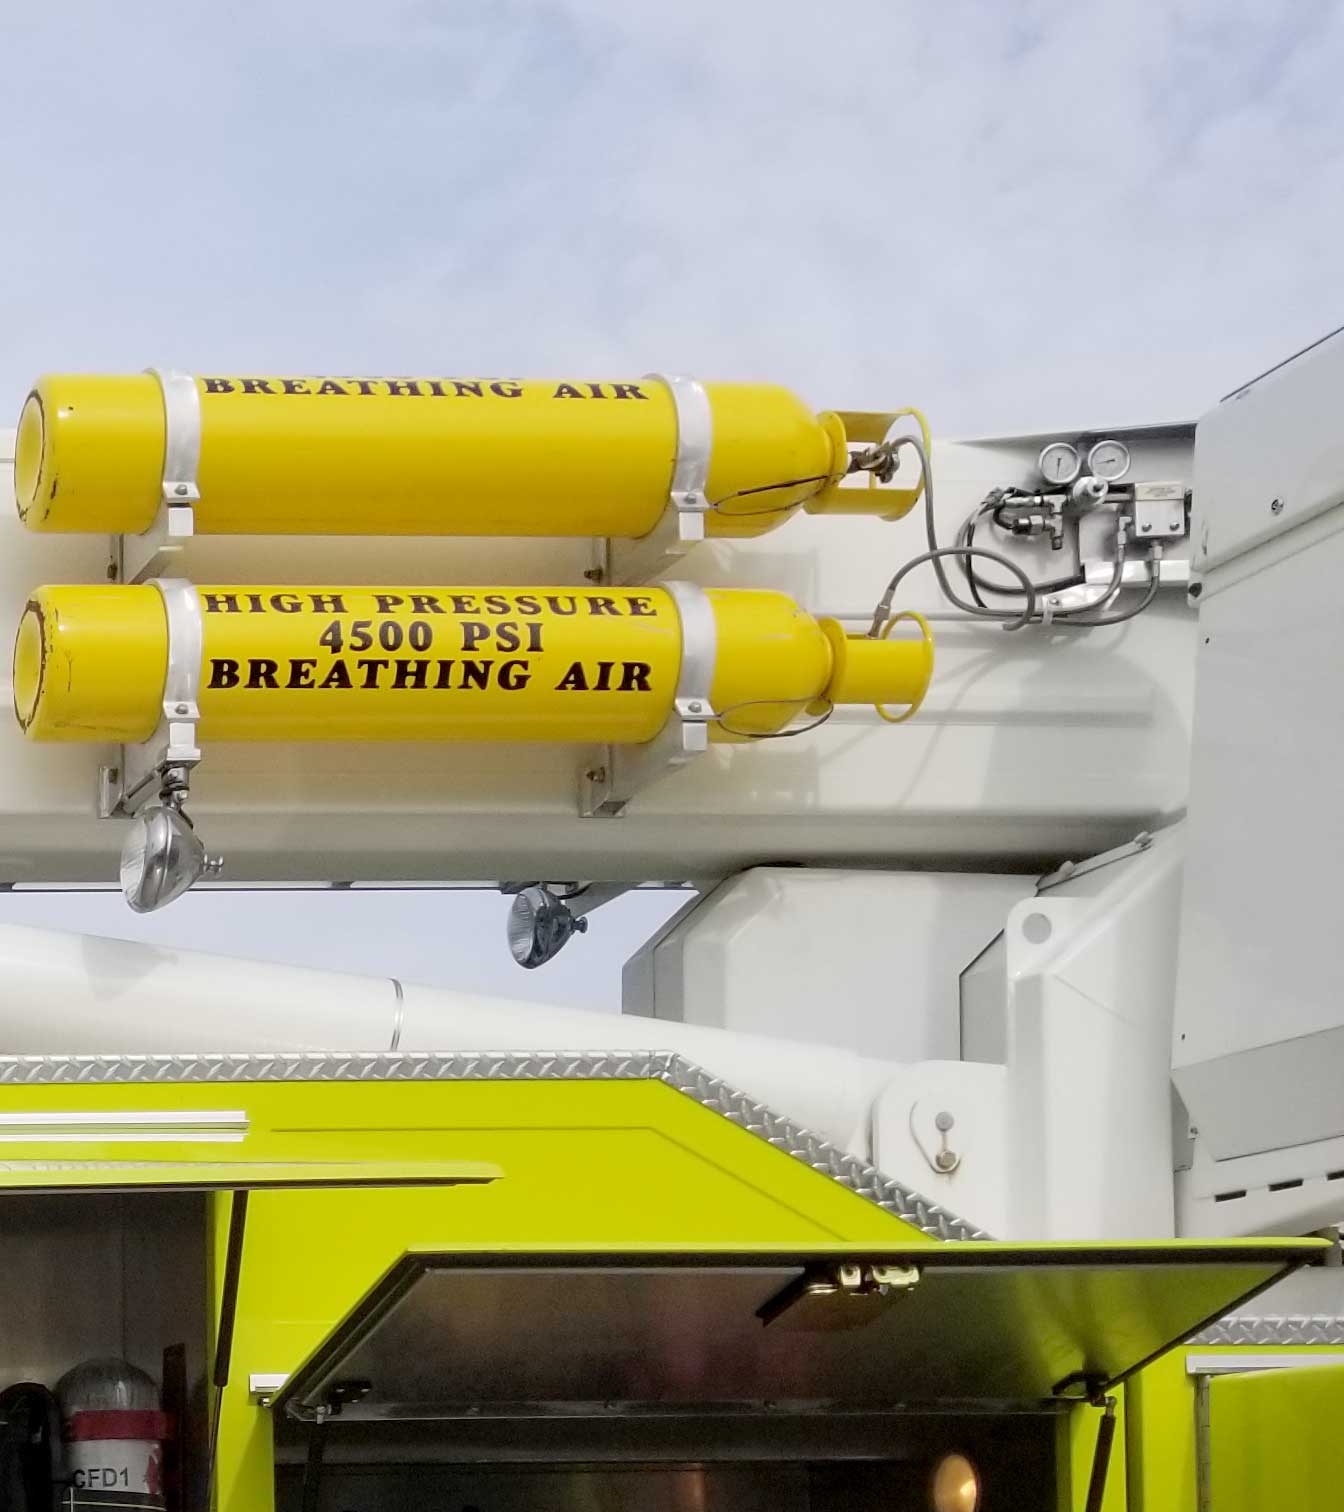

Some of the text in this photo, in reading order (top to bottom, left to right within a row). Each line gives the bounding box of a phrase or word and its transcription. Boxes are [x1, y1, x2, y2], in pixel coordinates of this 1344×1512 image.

[201, 377, 651, 401] BREATHING AIR
[202, 593, 658, 617] HIGH PRESSURE
[318, 619, 545, 654] 4500 PSI
[206, 658, 653, 692] BREATHING AIR
[72, 1467, 129, 1489] CFD1
